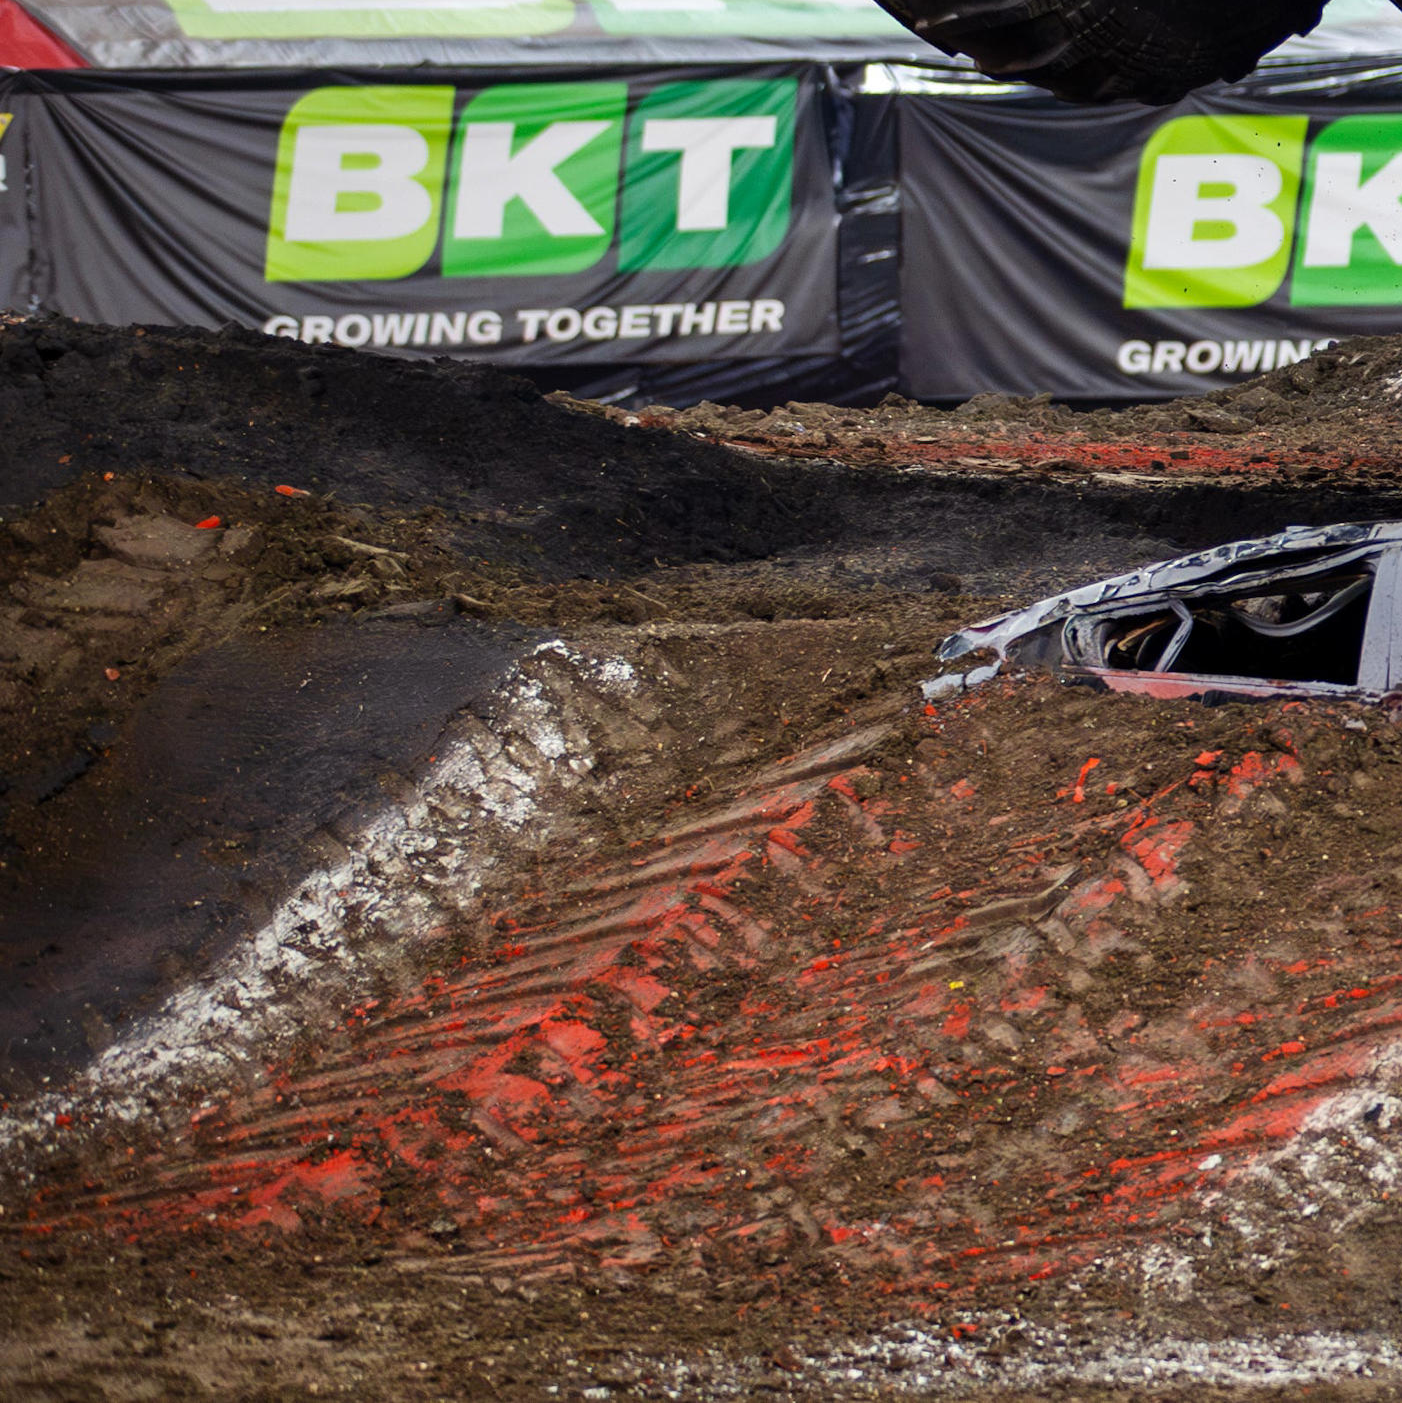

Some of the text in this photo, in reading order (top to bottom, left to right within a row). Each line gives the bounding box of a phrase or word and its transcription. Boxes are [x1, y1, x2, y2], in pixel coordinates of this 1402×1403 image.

[284, 115, 778, 242] BKT
[263, 299, 785, 348] GROWING TOGETHER
